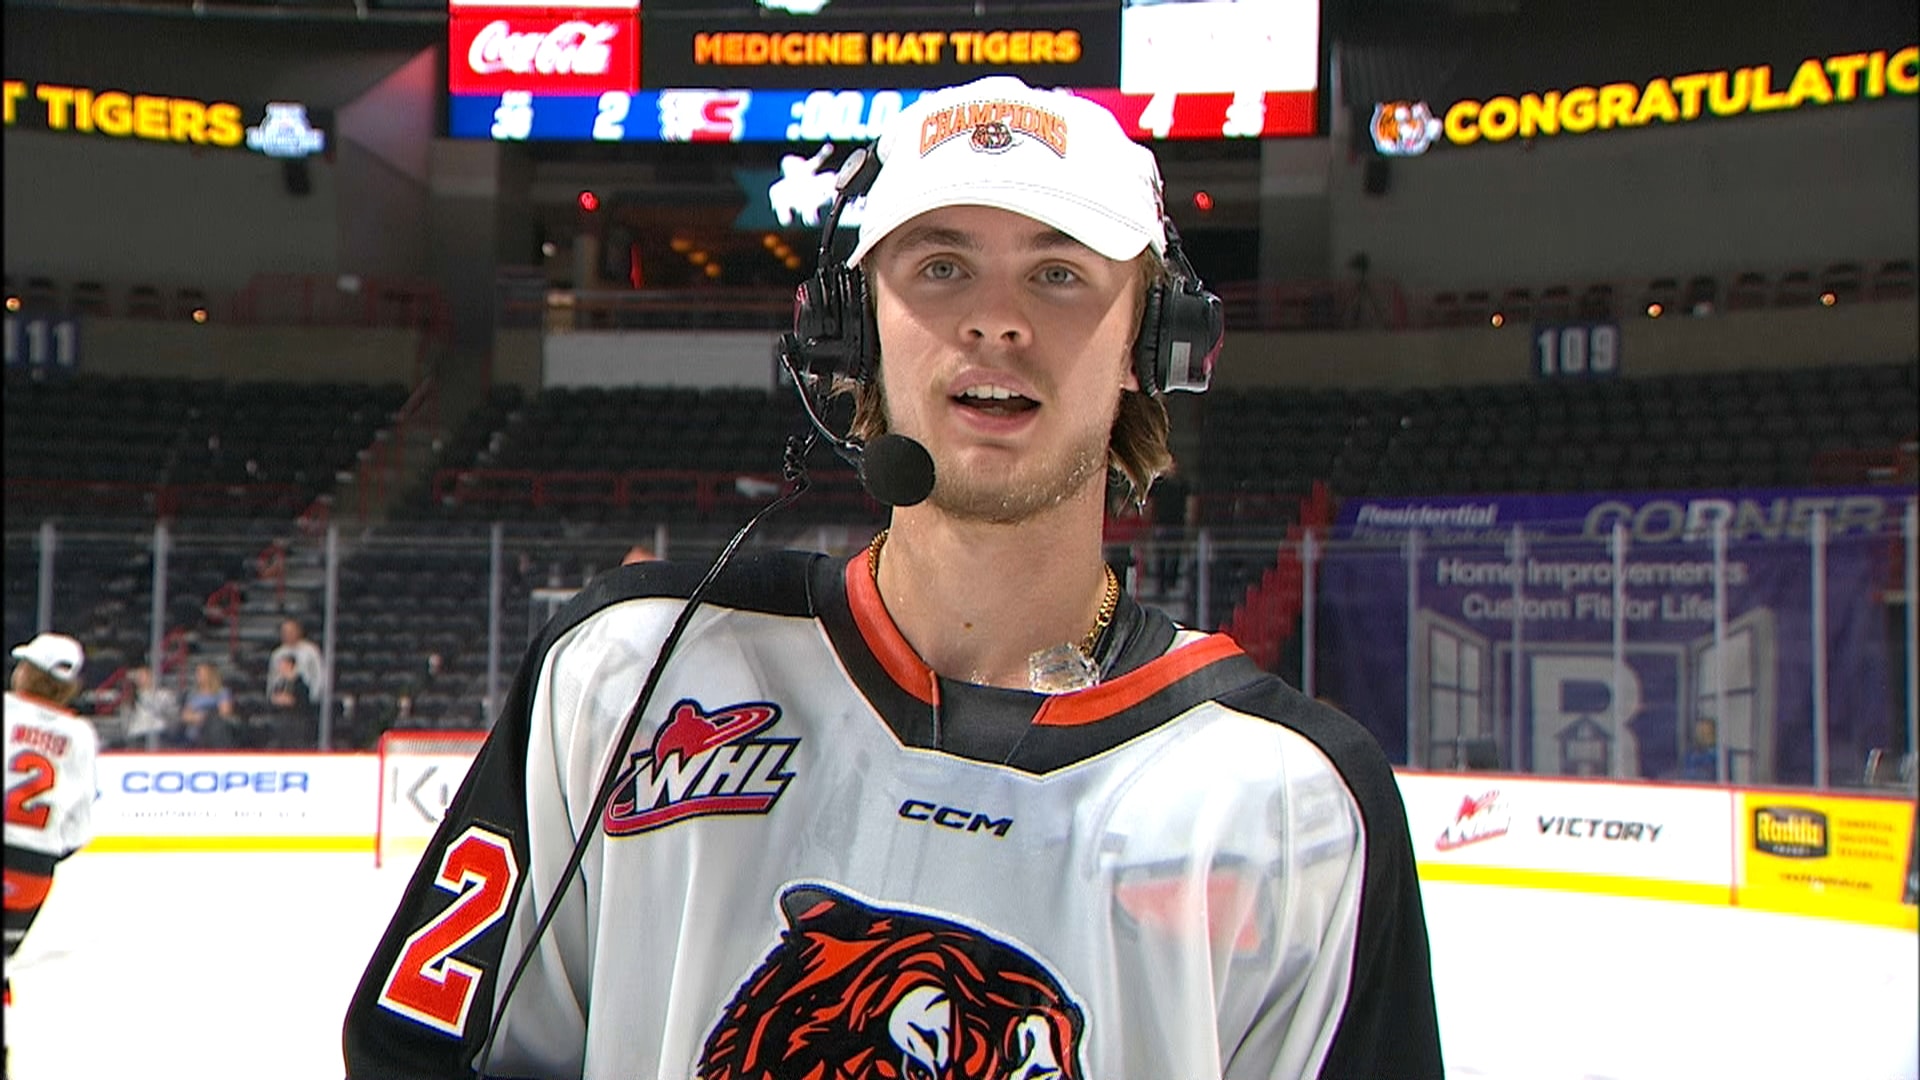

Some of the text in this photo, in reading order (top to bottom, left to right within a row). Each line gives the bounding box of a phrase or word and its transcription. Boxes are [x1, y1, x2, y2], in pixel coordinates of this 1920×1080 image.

[694, 30, 1082, 64] MEDICINE HAT TIGERS
[36, 84, 244, 147] TIGERS
[593, 91, 631, 139] 2
[919, 100, 1067, 156] CHAMPIONS
[1538, 327, 1617, 376] 109
[1356, 503, 1499, 527] Residential
[1437, 558, 1746, 590] Home Improemens
[1463, 593, 1570, 620] Custom
[1661, 593, 1717, 620] Life
[5, 750, 55, 830] 2
[122, 771, 309, 793] COOPER
[630, 738, 798, 816] WHL
[899, 799, 1013, 838] CCM
[1538, 815, 1663, 843] VICTORY
[378, 826, 519, 1038] 2
